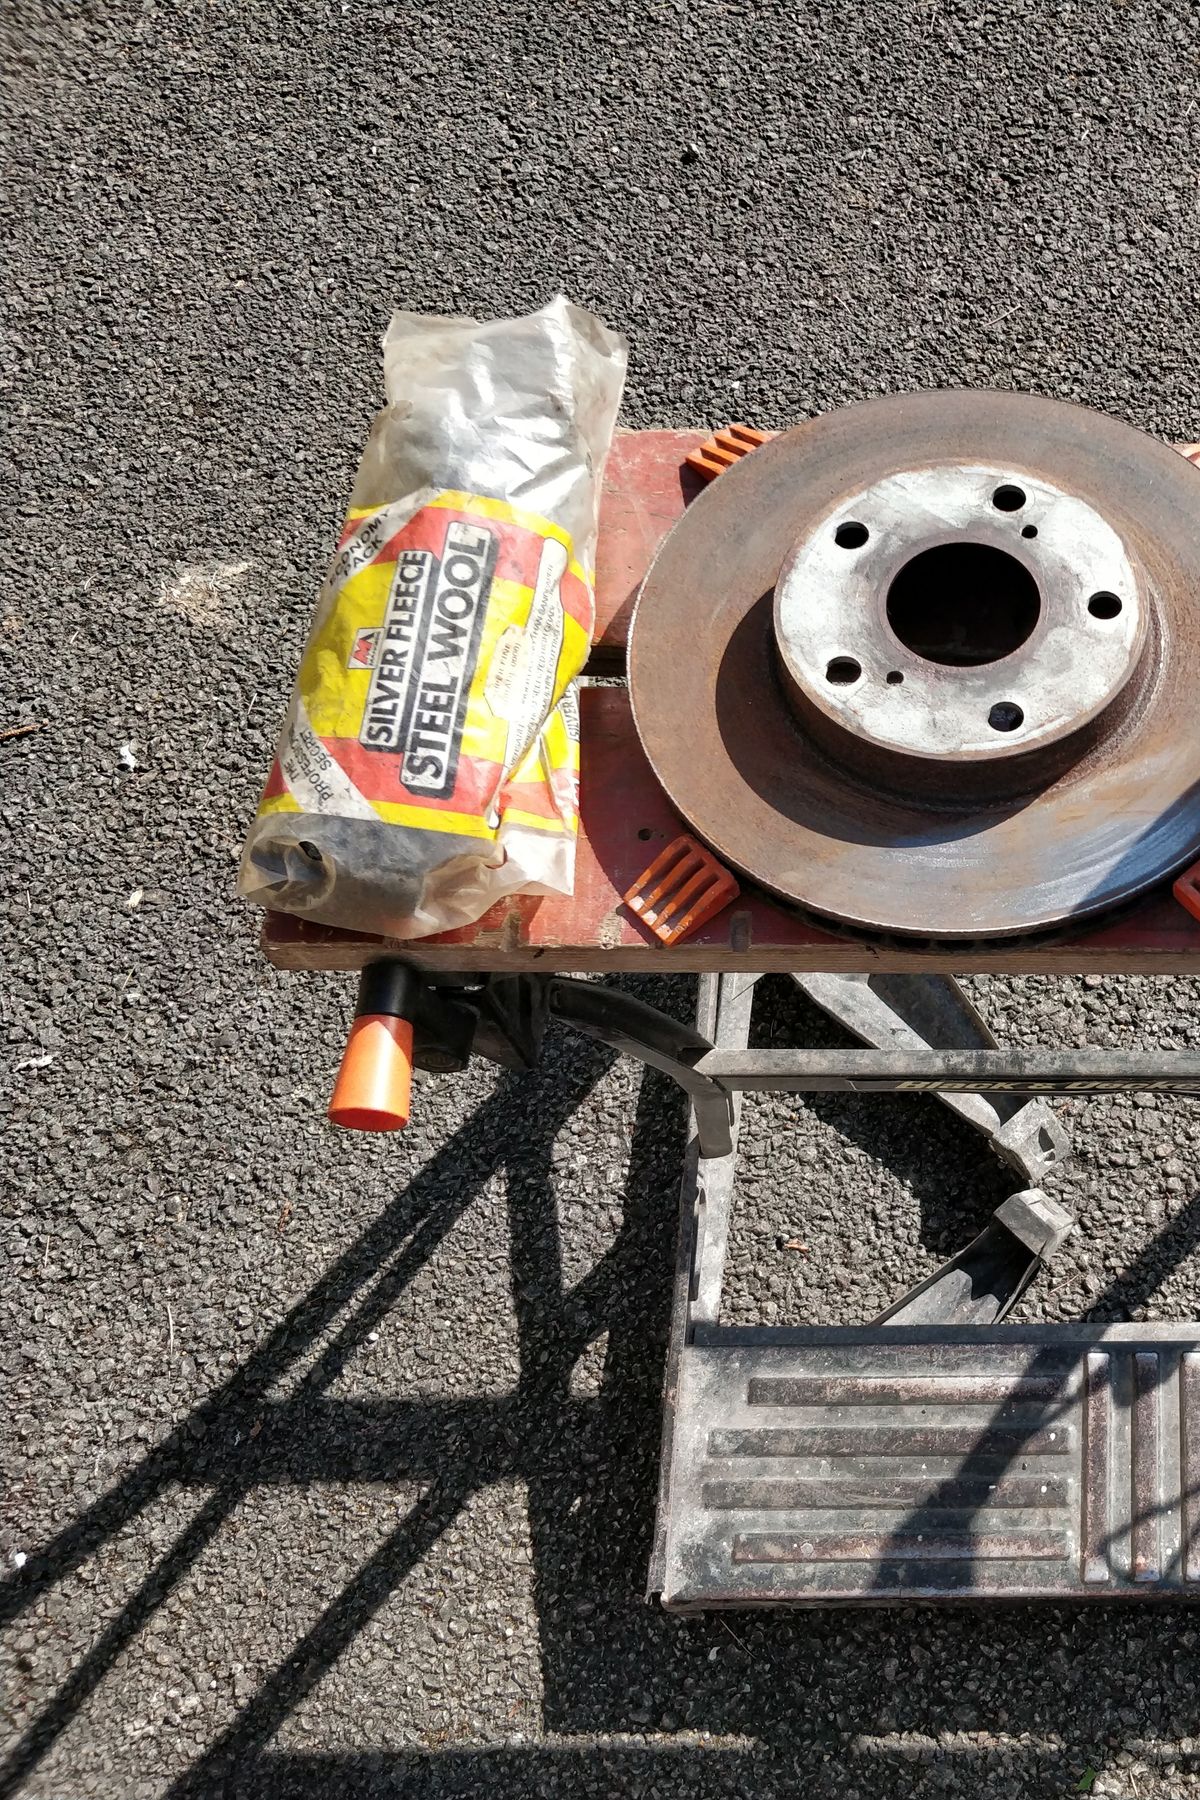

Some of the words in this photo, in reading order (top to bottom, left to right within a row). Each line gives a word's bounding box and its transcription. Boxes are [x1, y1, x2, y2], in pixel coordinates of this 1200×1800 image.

[329, 508, 390, 586] ECONOMY
[344, 534, 383, 577] PACK
[387, 551, 427, 642] FLEECE
[428, 537, 487, 660] WOOL
[366, 648, 411, 745] SILVER
[406, 675, 459, 780] STEEL
[284, 758, 300, 783] THE
[895, 1080, 1015, 1090] Black
